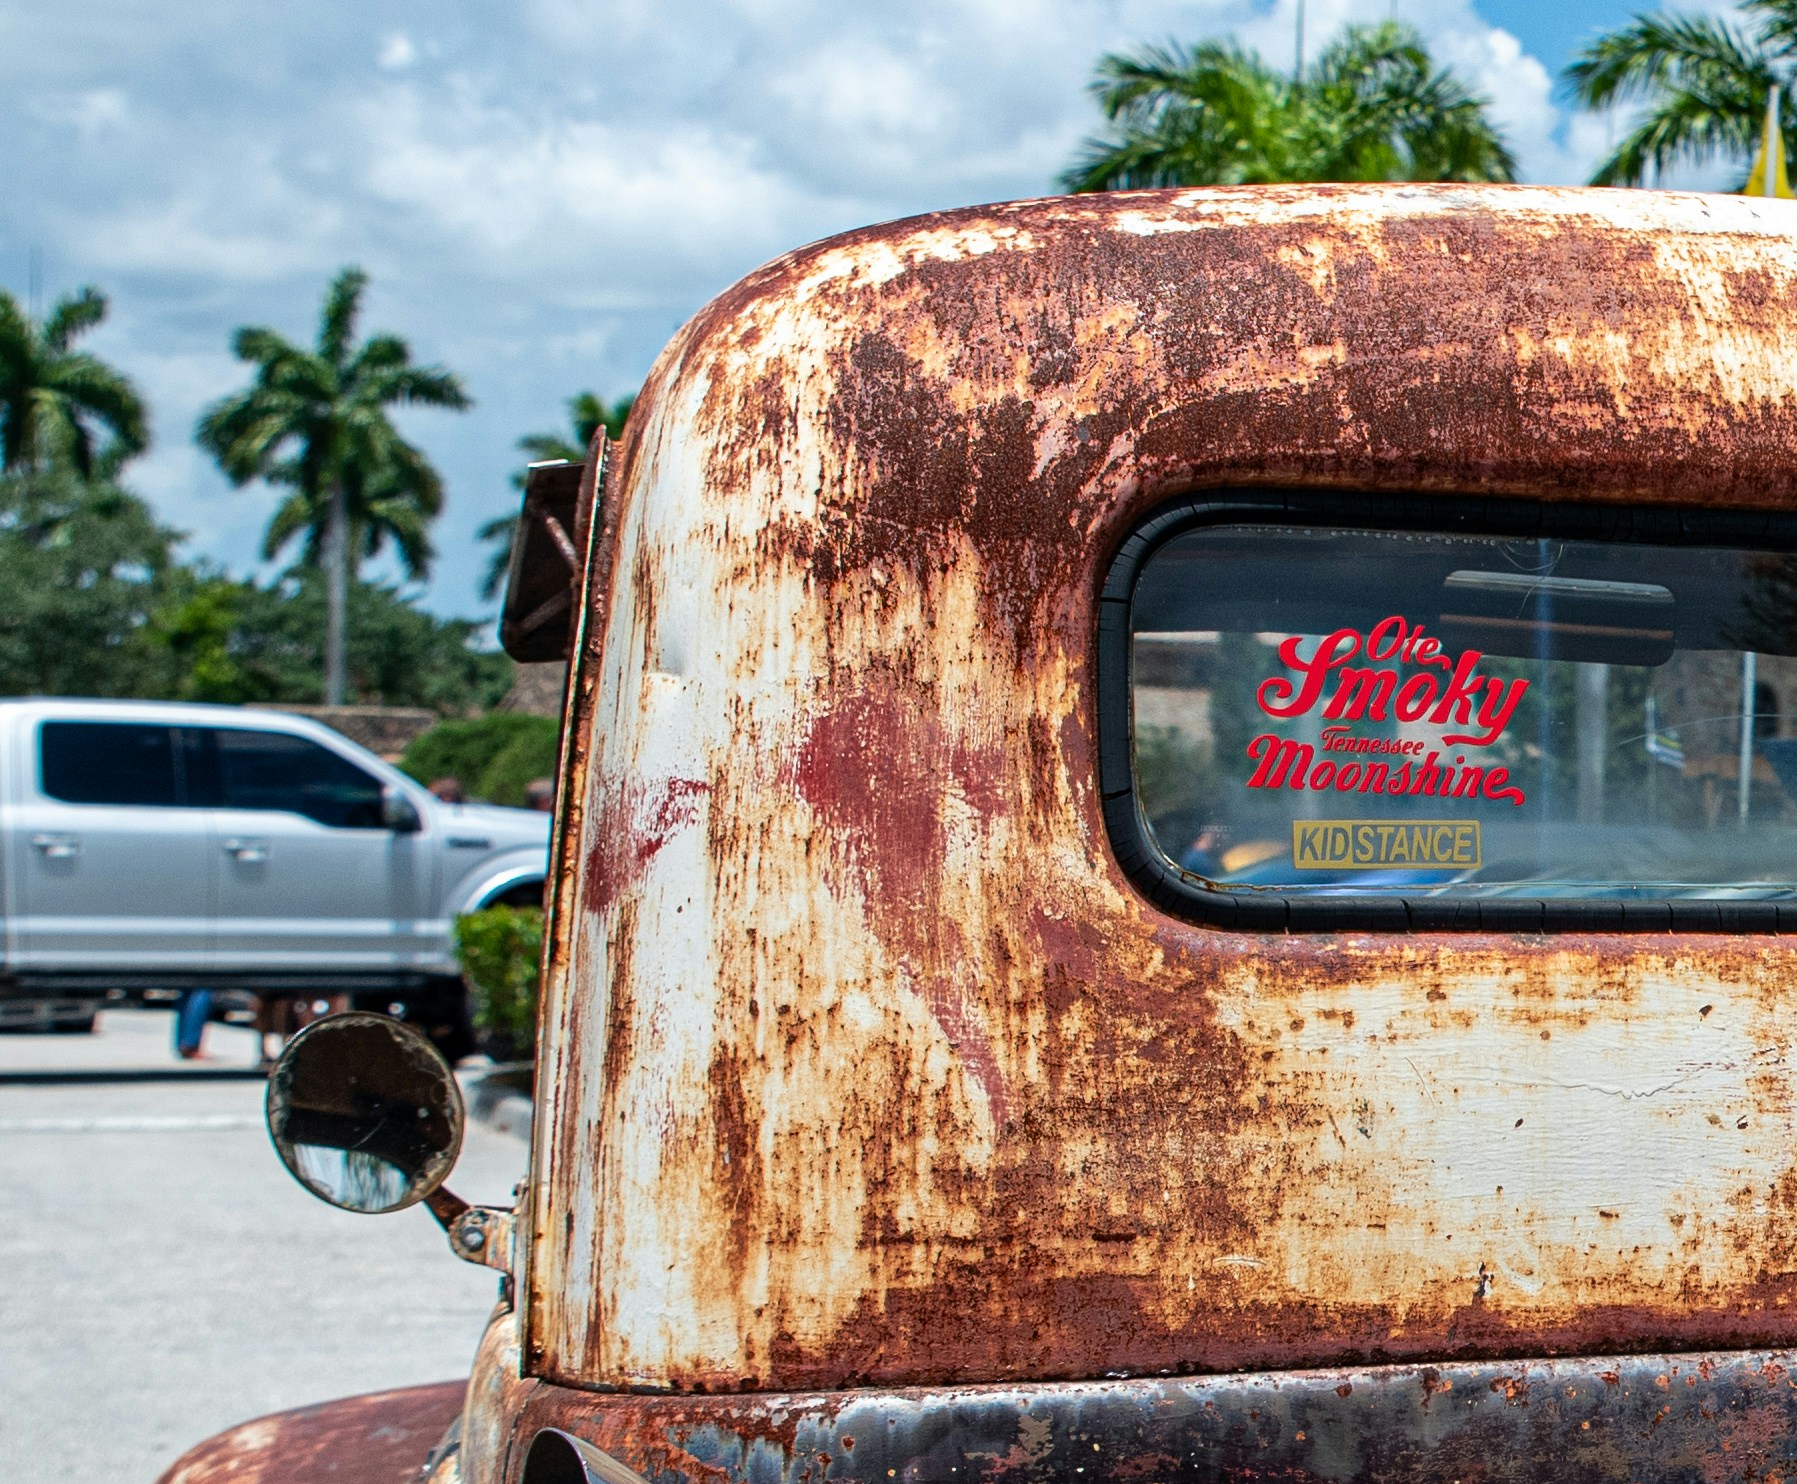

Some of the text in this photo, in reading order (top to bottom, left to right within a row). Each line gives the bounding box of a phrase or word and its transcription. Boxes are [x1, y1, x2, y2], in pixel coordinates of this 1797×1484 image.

[1366, 615, 1452, 670] Ole
[1256, 628, 1530, 746] Smoky
[1246, 734, 1525, 806] Moonshine
[1320, 726, 1424, 755] Tennessee
